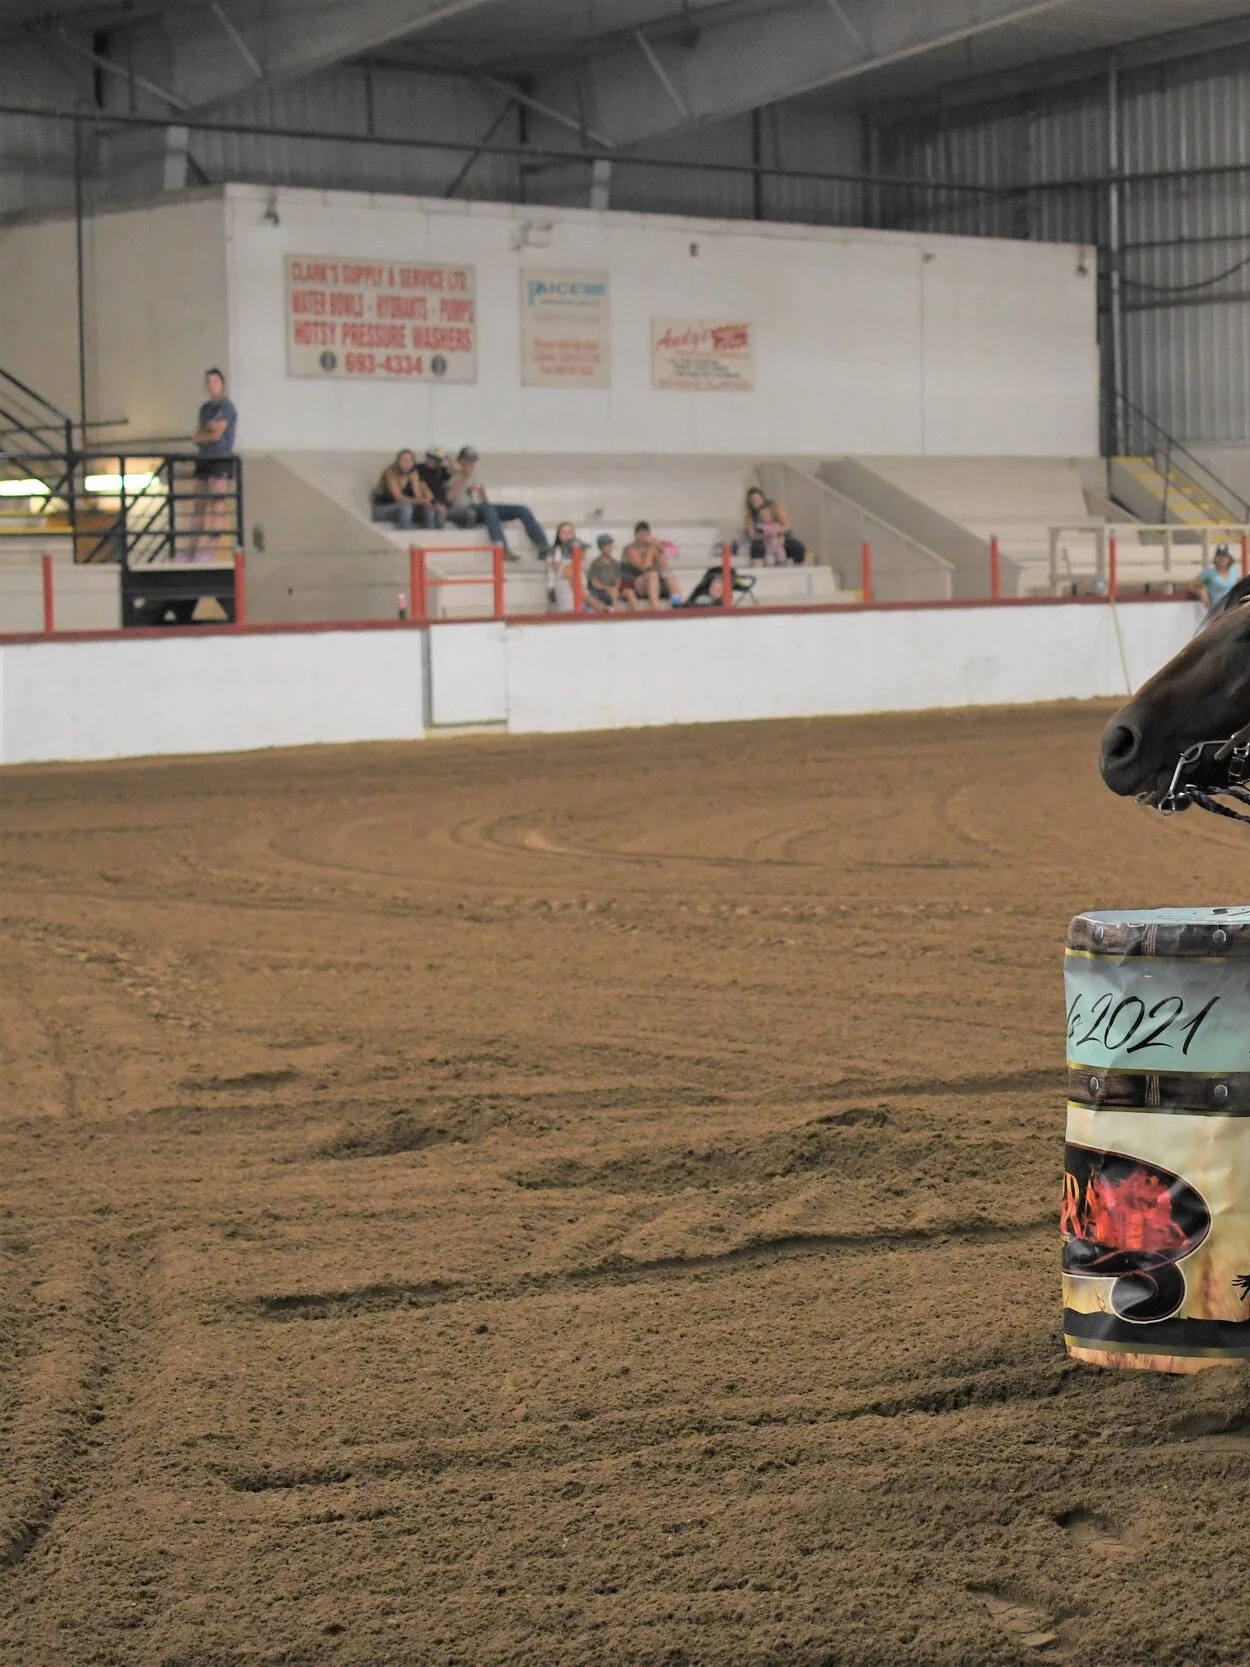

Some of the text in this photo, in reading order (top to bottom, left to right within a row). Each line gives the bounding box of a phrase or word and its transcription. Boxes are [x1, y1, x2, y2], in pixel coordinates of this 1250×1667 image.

[343, 265, 383, 286] SUPPLY
[400, 268, 444, 290] SERVICE
[293, 289, 324, 315] WATER
[330, 292, 363, 317] BOWLS
[376, 295, 428, 321] HYDRANTS
[441, 298, 474, 323] PUMPS
[295, 321, 472, 352] HOTSY PRESSURE WASHERS
[346, 352, 423, 374] 693-4334
[1076, 992, 1220, 1056] 2021
